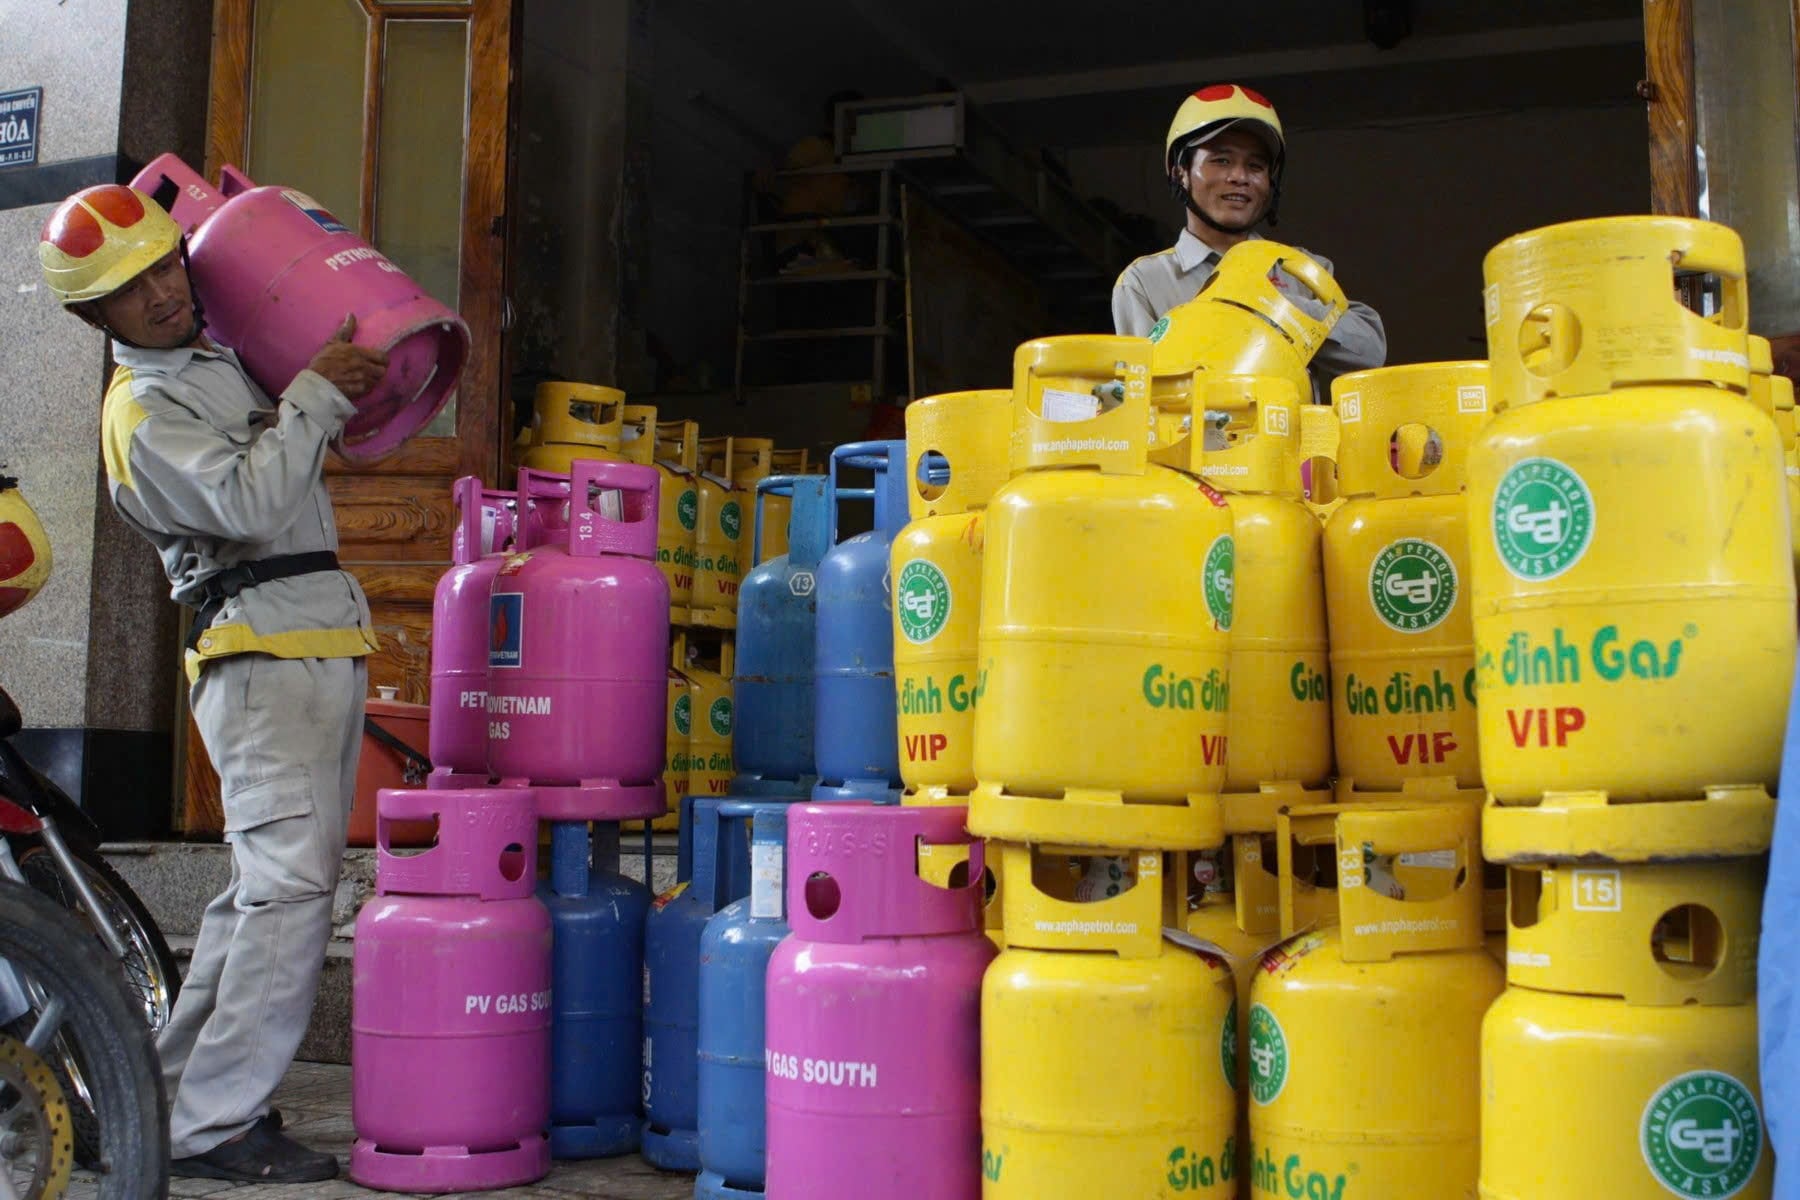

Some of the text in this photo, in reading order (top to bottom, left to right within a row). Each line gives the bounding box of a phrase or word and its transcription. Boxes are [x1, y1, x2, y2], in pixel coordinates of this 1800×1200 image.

[1128, 364, 1147, 399] 13.5
[1268, 412, 1286, 431] 15
[1343, 398, 1357, 417] 16
[579, 511, 593, 541] 13.4
[1396, 611, 1432, 629] ASP
[1502, 627, 1580, 686] đình
[1592, 624, 1683, 682] Gas
[902, 676, 942, 715] đình
[1142, 663, 1195, 710] Gia
[1346, 672, 1379, 716] Gia
[1384, 669, 1457, 714] đình
[488, 721, 510, 740] GAS
[1506, 707, 1587, 748] VIP
[905, 733, 948, 762] VIP
[1340, 846, 1362, 889] 13.8
[1582, 877, 1614, 903] 15
[465, 994, 491, 1014] PV
[495, 993, 528, 1014] GAS
[772, 1051, 799, 1081] GAS
[802, 1057, 877, 1088] SOUTH
[1650, 1079, 1755, 1134] ANPHA PETROL
[1167, 1145, 1215, 1191] Gia
[1680, 1173, 1730, 1195] ASP
